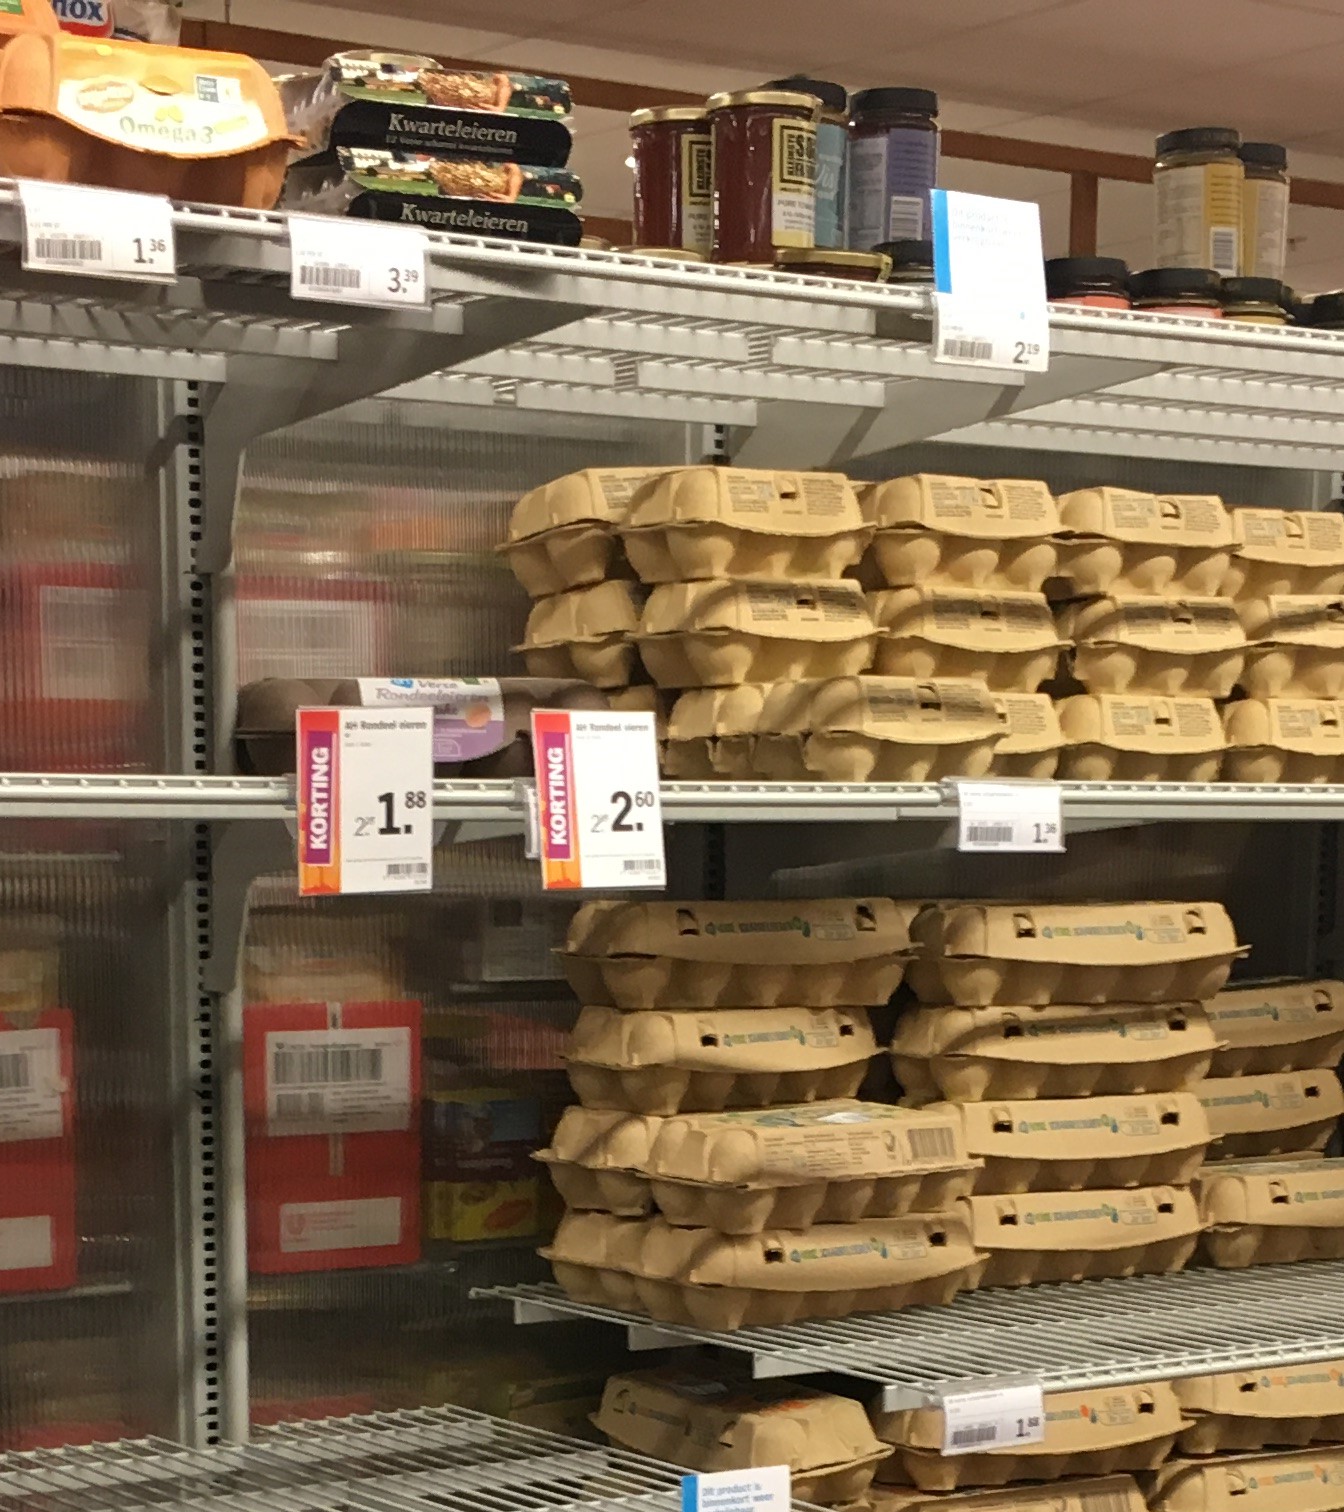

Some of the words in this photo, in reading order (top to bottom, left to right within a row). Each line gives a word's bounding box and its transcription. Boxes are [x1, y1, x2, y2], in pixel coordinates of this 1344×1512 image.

[120, 116, 197, 144] Omega
[202, 125, 214, 143] 3
[389, 113, 517, 144] Kwarteleieren
[400, 202, 528, 233] Kwarteleieren
[132, 237, 166, 265] 1.36
[387, 266, 418, 294] 3.39
[310, 747, 331, 850] KORTING
[550, 747, 568, 845] KORTING
[377, 791, 427, 837] 1.88
[609, 790, 655, 834] 2.60
